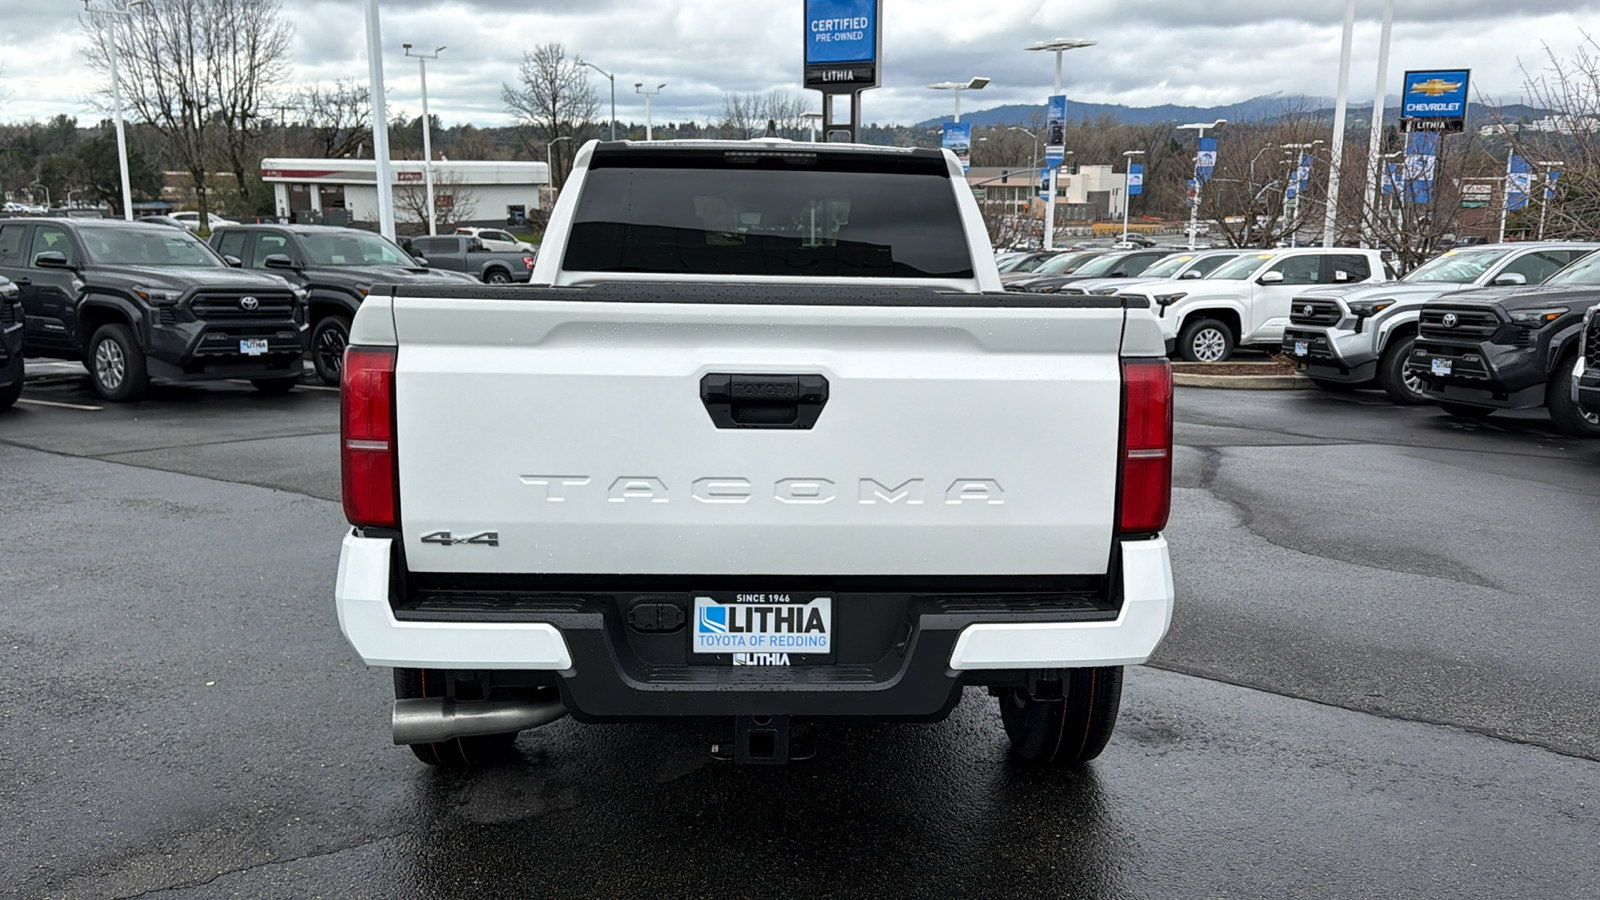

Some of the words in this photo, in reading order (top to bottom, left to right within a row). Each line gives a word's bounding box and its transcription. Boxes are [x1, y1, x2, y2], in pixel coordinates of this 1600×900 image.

[811, 17, 868, 31] CERTIFIED
[815, 31, 864, 42] PRE-OWNED
[822, 70, 854, 82] LITHIA
[1406, 102, 1461, 111] CHEVROLET
[1416, 121, 1446, 129] LITHIA
[734, 383, 795, 396] TOYOTA
[519, 474, 1005, 504] TACOMA
[736, 594, 765, 603] SINCE
[768, 594, 790, 603] 1946
[728, 606, 826, 634] LITHIA
[698, 635, 746, 647] TOYOTA
[749, 635, 766, 647] OF
[769, 635, 827, 647] REDDING
[745, 653, 790, 665] LITHIA
